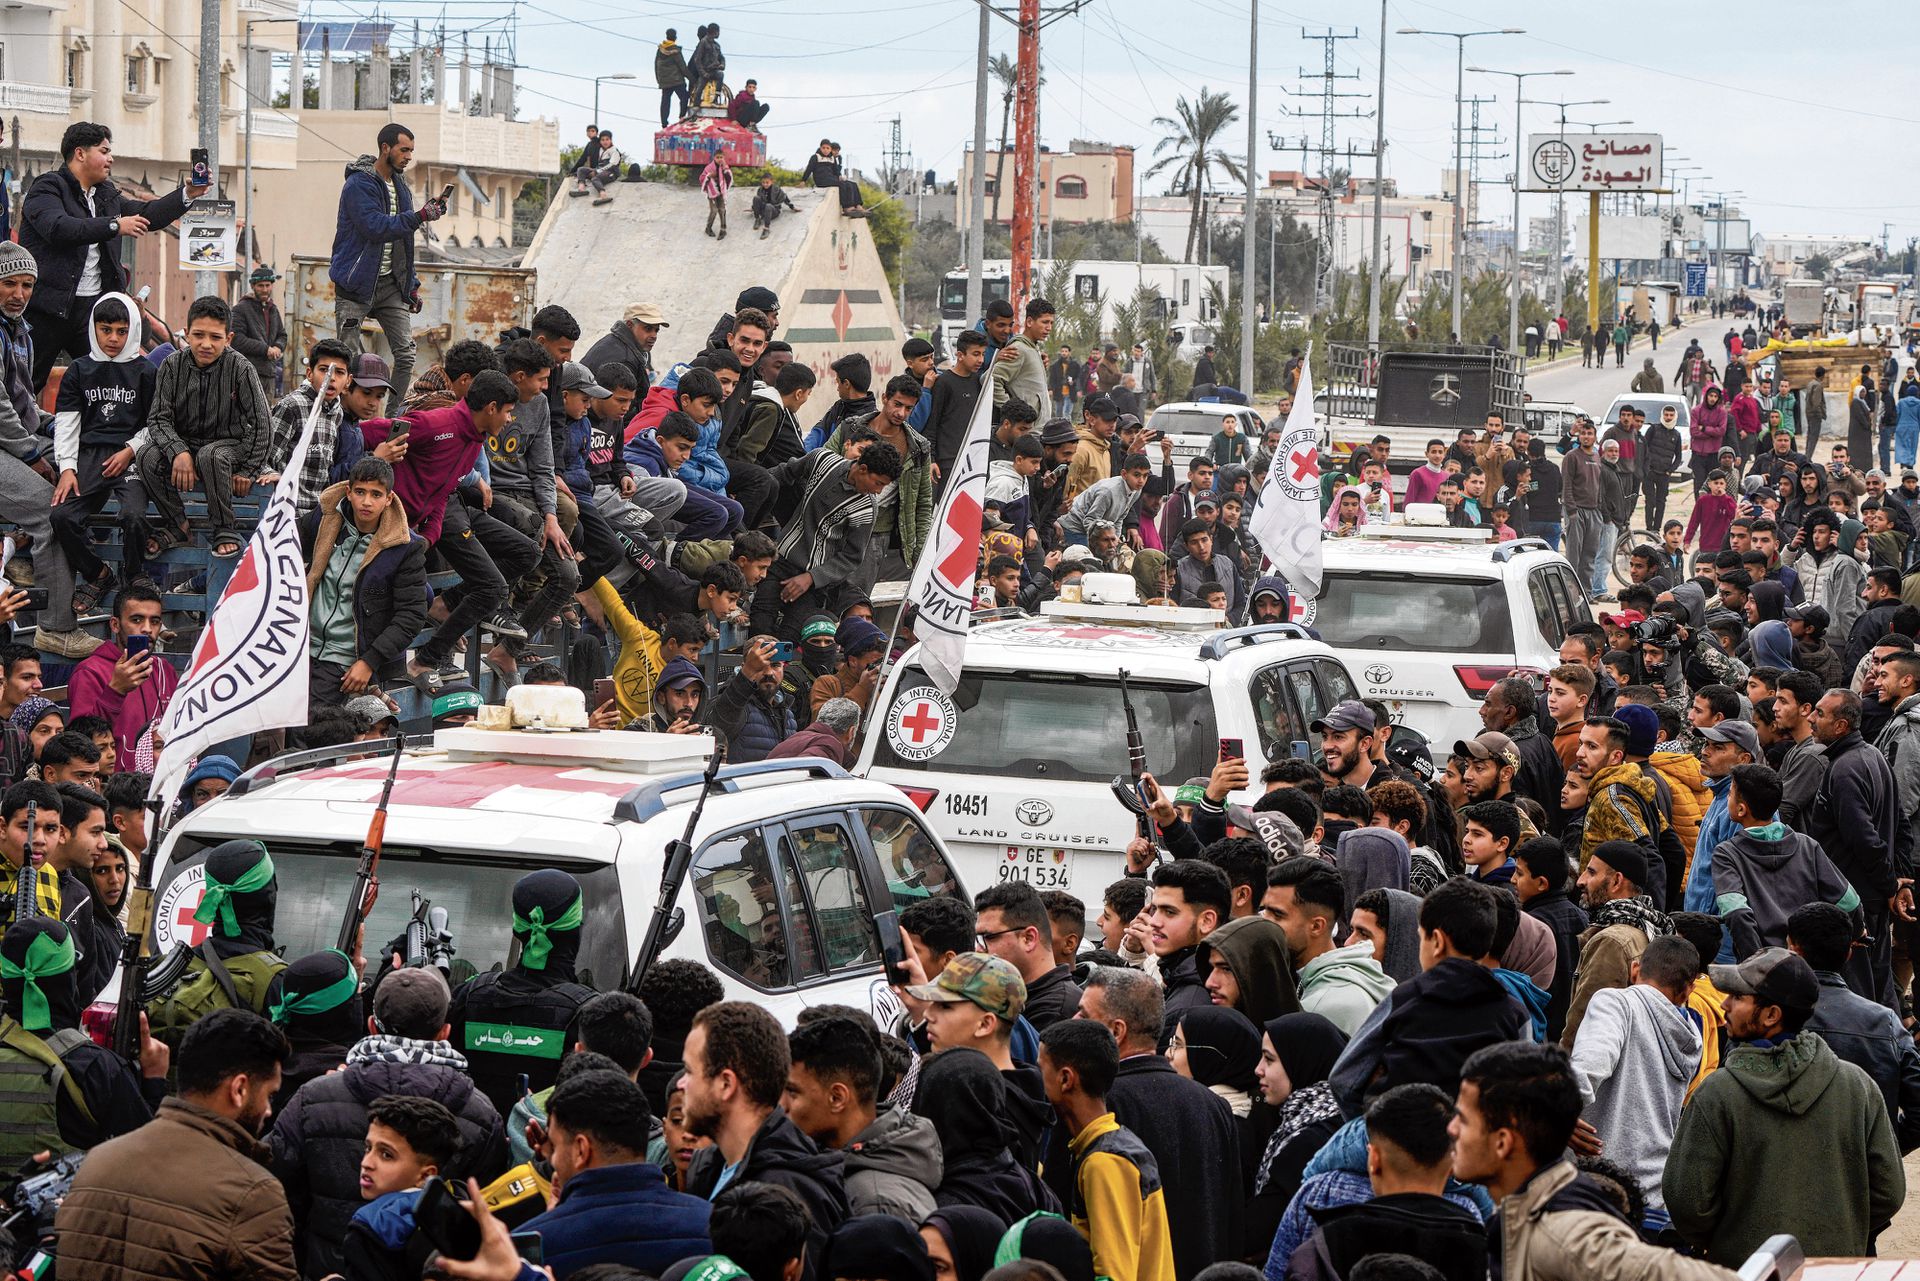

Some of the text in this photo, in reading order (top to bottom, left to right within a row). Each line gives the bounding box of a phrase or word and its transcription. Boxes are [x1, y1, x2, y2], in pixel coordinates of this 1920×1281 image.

[1582, 139, 1652, 163] مصانع
[1581, 165, 1652, 187] العودة
[1368, 687, 1435, 697] CRUISER
[887, 687, 955, 745] COMITE INTERNATIONAL
[895, 742, 937, 759] GENEVE
[945, 793, 988, 817] 18451
[957, 827, 1109, 845] LAND CRUISER
[1026, 848, 1044, 863] GE
[1035, 867, 1068, 888] 534
[157, 880, 183, 942] COMITE
